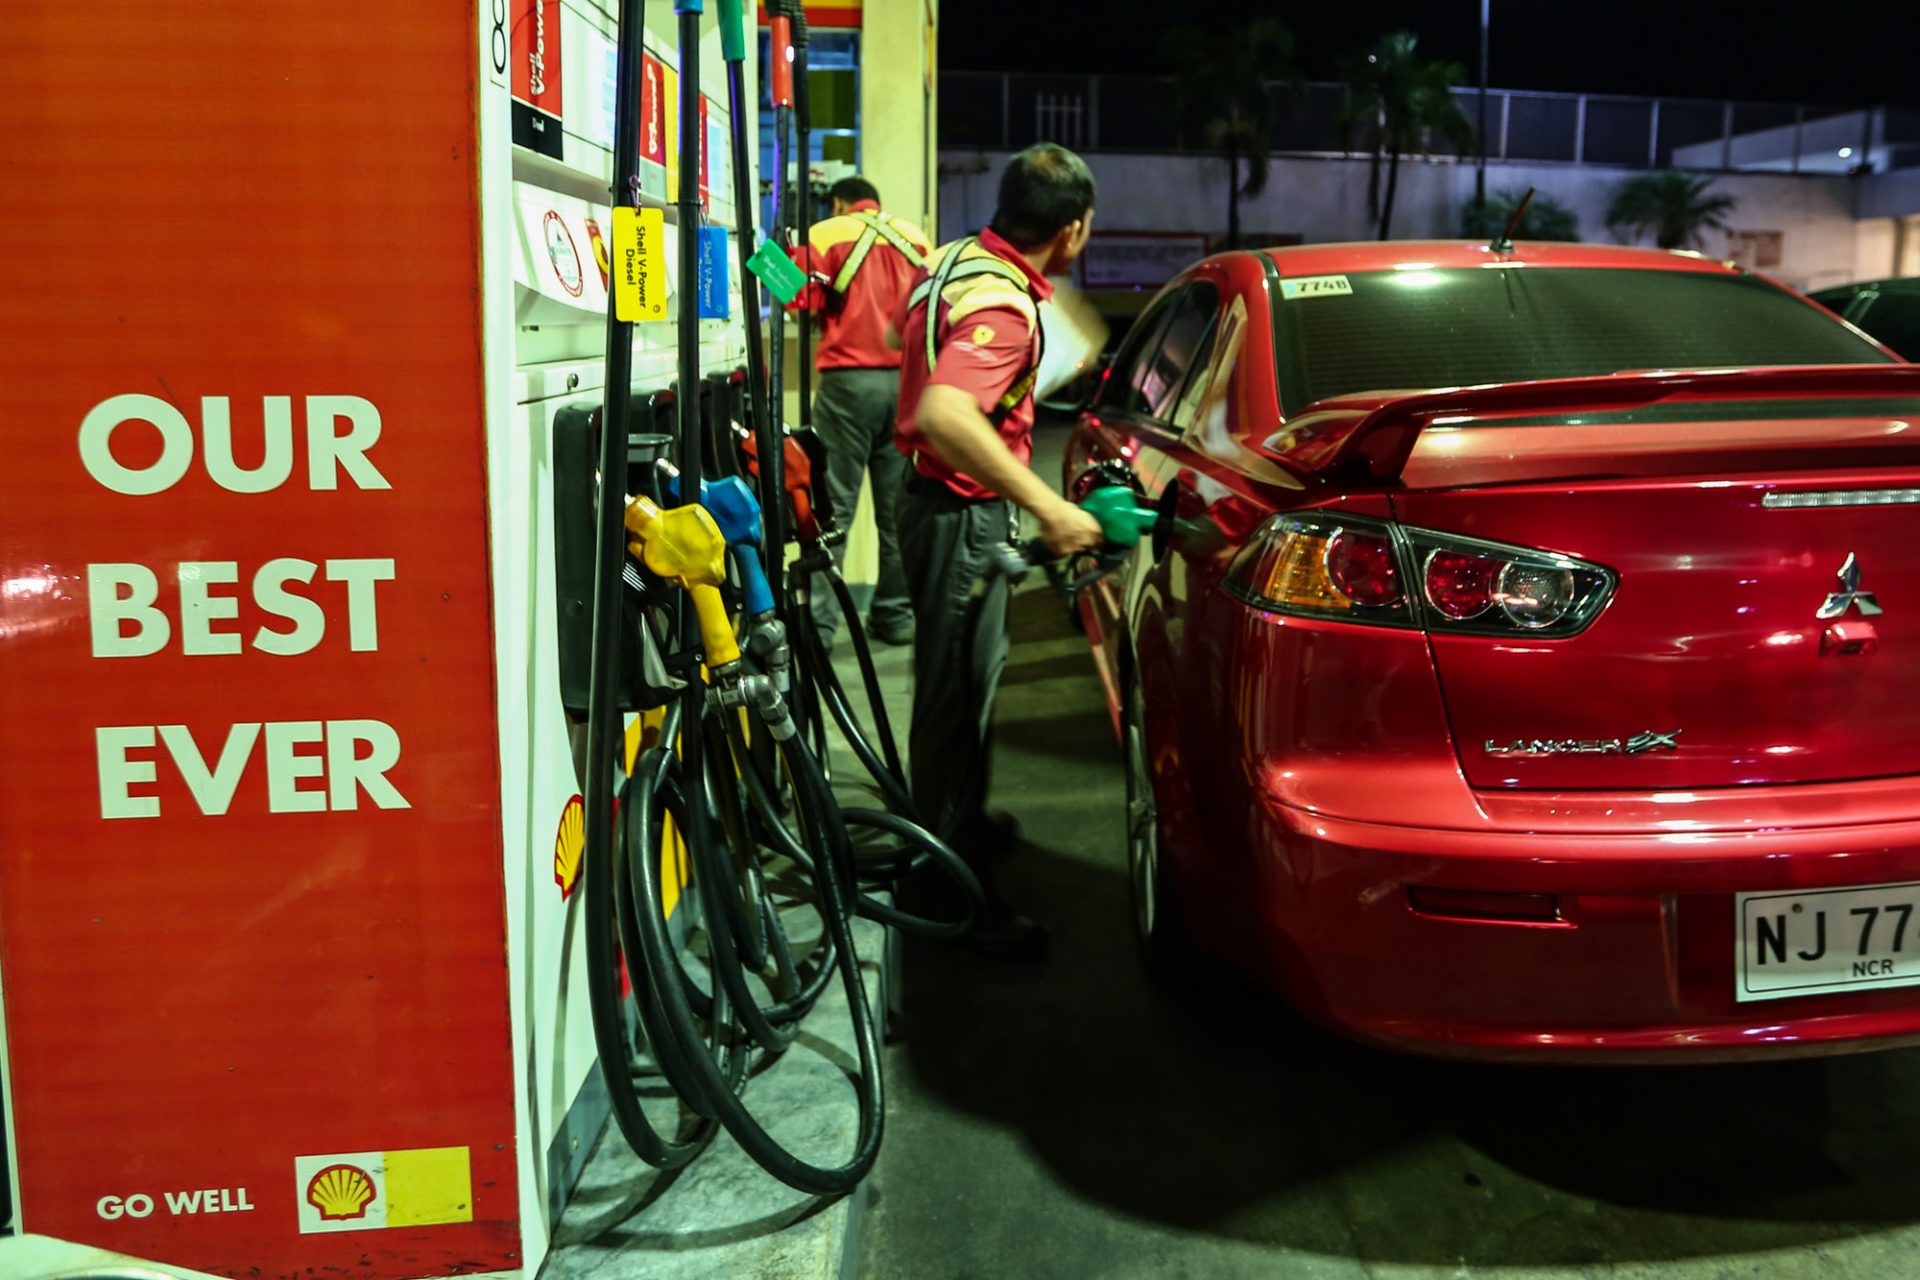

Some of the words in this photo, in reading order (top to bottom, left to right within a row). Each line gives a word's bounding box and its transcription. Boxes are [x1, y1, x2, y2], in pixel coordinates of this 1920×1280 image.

[636, 226, 647, 255] Shell
[703, 241, 712, 264] Shell
[626, 248, 636, 285] Diesel
[637, 259, 647, 308] V-Power
[704, 267, 712, 309] V-Power
[78, 393, 392, 495] OUR
[88, 558, 395, 658] BEST
[1485, 739, 1621, 753] LANCER
[96, 719, 412, 819] EVER
[1850, 904, 1920, 956] 77
[1853, 959, 1894, 977] NCR
[97, 1194, 153, 1220] GO
[164, 1188, 254, 1214] WELL
